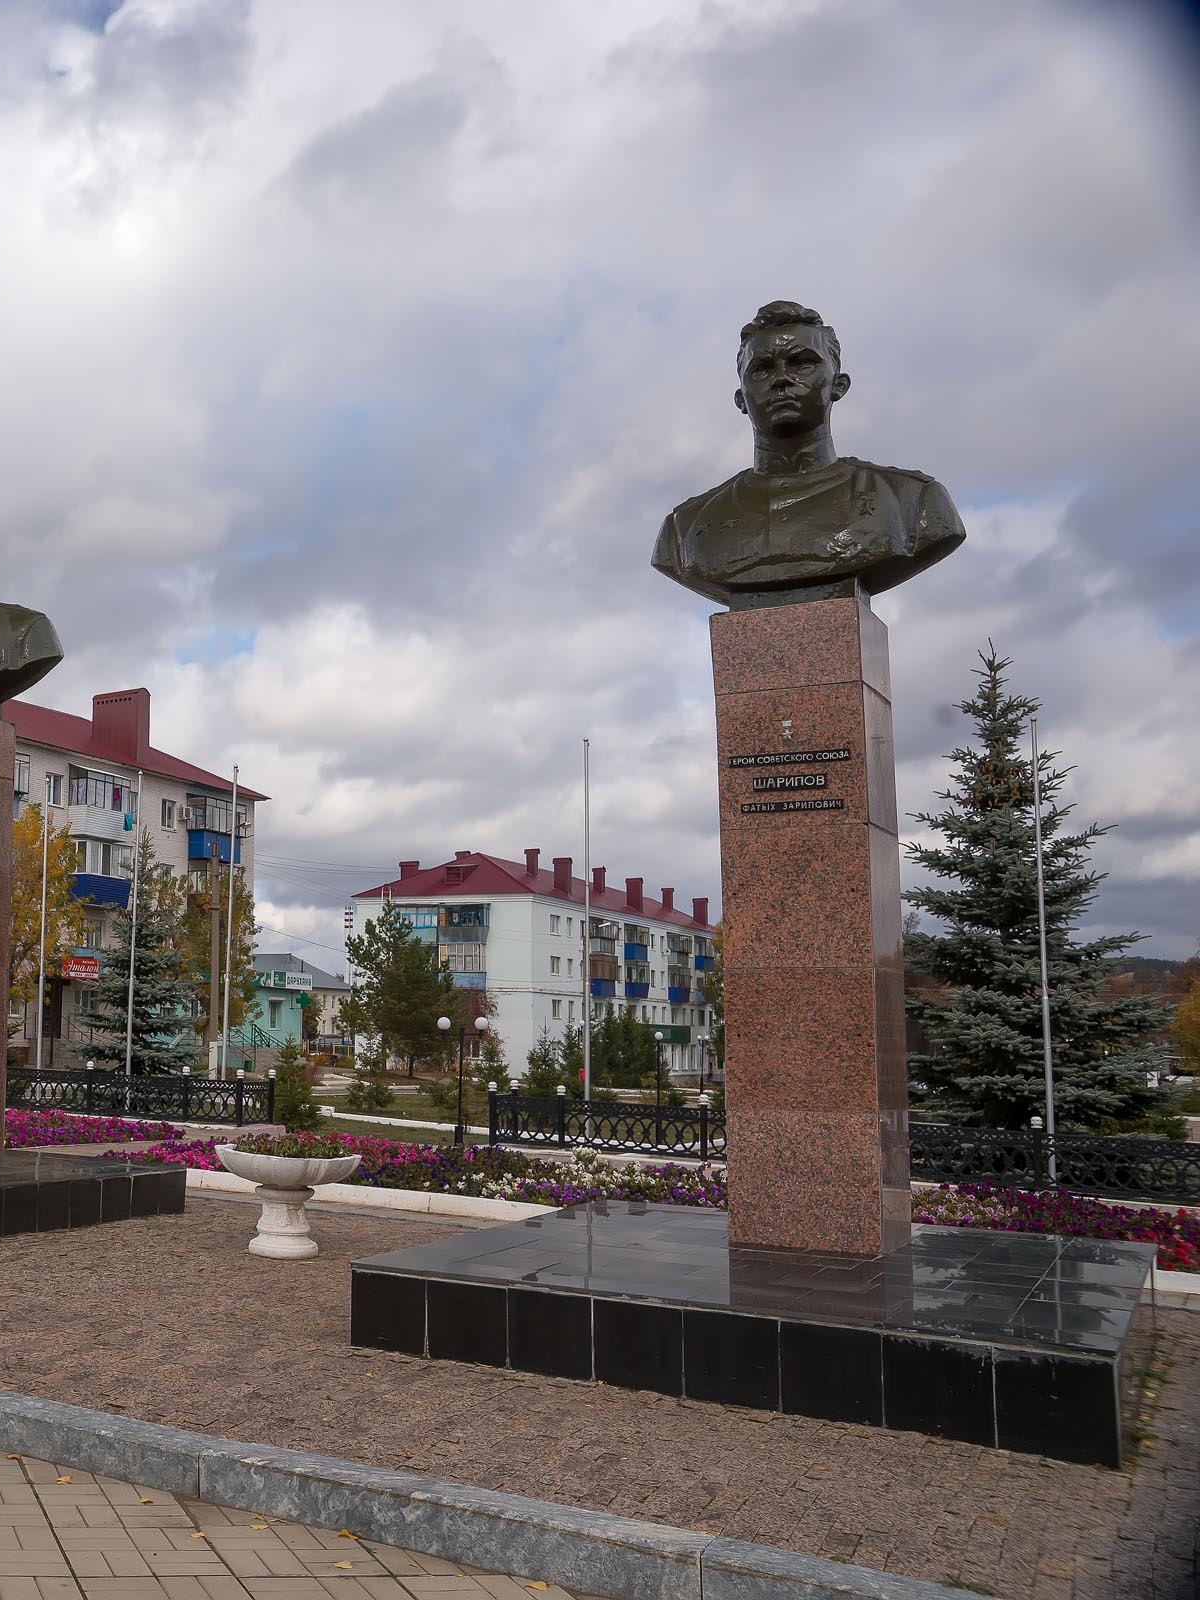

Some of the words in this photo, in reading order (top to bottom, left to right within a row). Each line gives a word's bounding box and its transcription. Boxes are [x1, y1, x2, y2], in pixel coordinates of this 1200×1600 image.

[757, 753, 814, 764] СОВЕТСКОГО
[816, 750, 850, 760] СОЮЗА
[753, 775, 825, 789] ШАРИПОВ
[742, 803, 776, 812] ФАТЫХ
[782, 800, 842, 810] ЗАРИПОВИЧ
